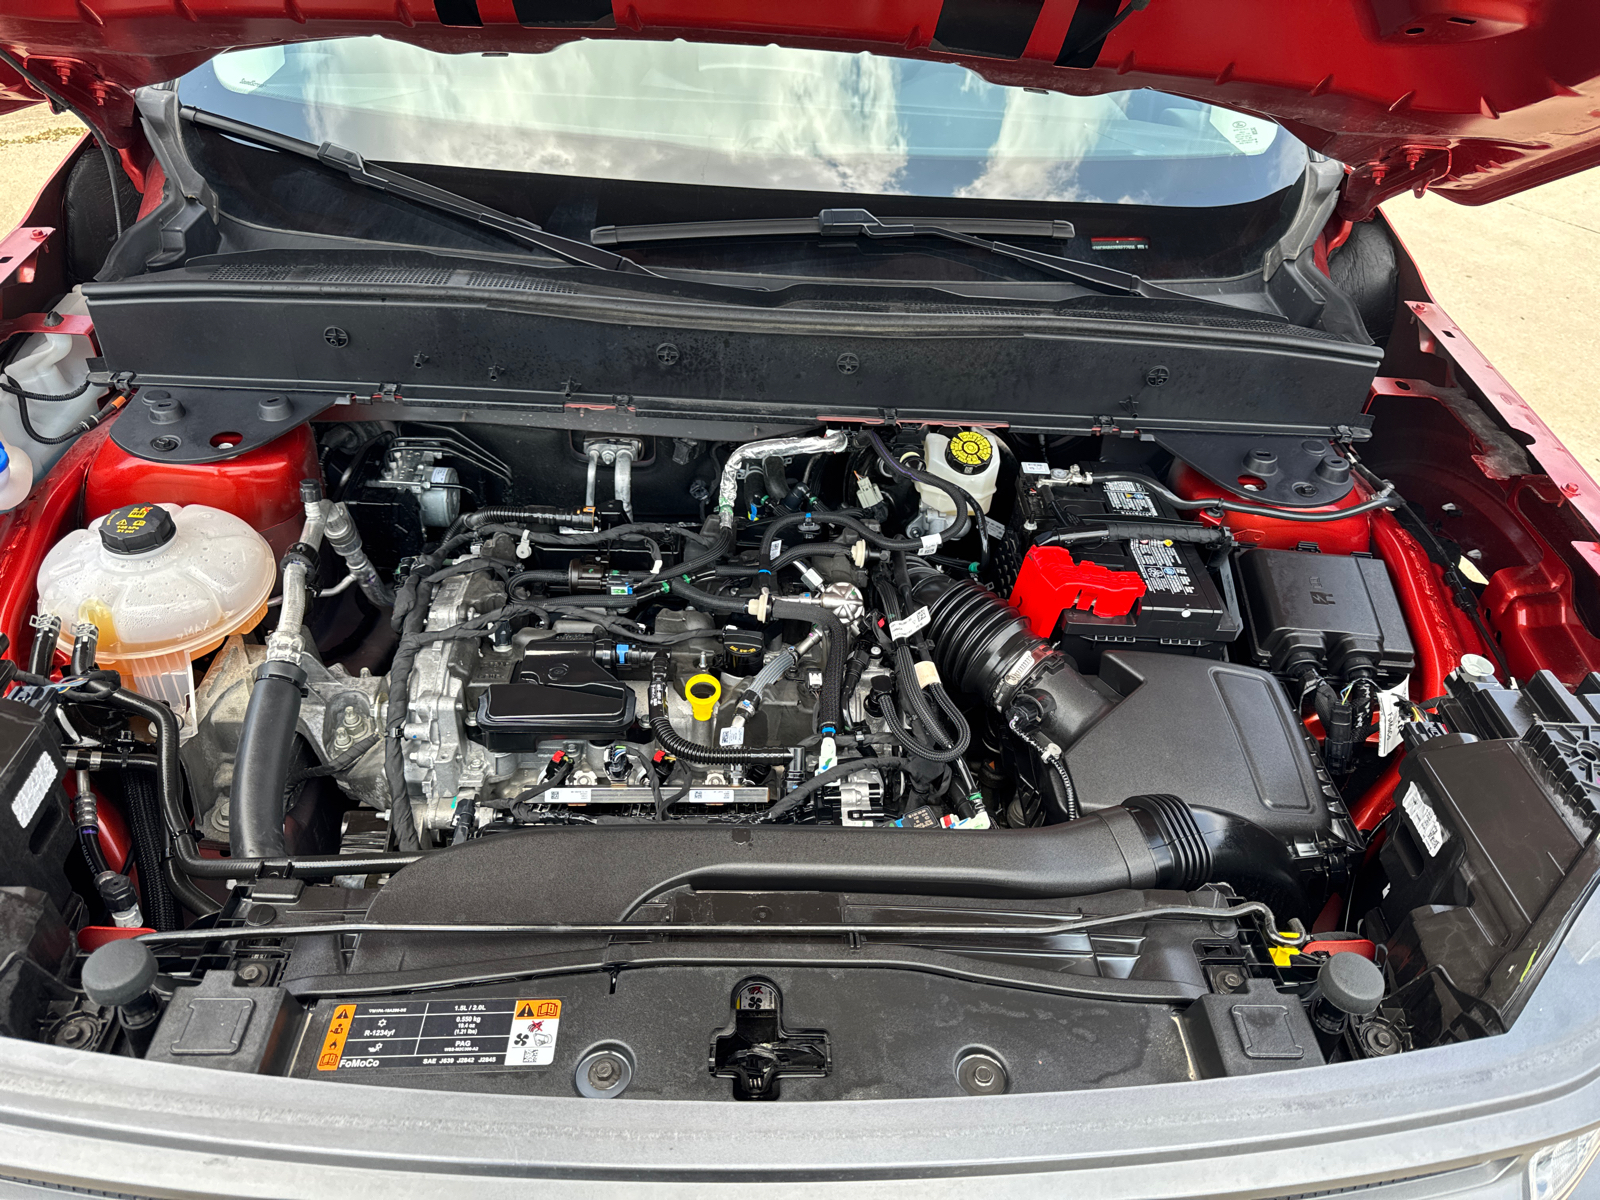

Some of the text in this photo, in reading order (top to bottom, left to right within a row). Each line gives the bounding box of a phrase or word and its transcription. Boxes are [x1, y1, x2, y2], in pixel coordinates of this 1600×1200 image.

[184, 619, 210, 637] MAX
[473, 1015, 481, 1023] kg
[363, 1028, 396, 1037] R-1234yf
[338, 1058, 380, 1068] FoMoCo
